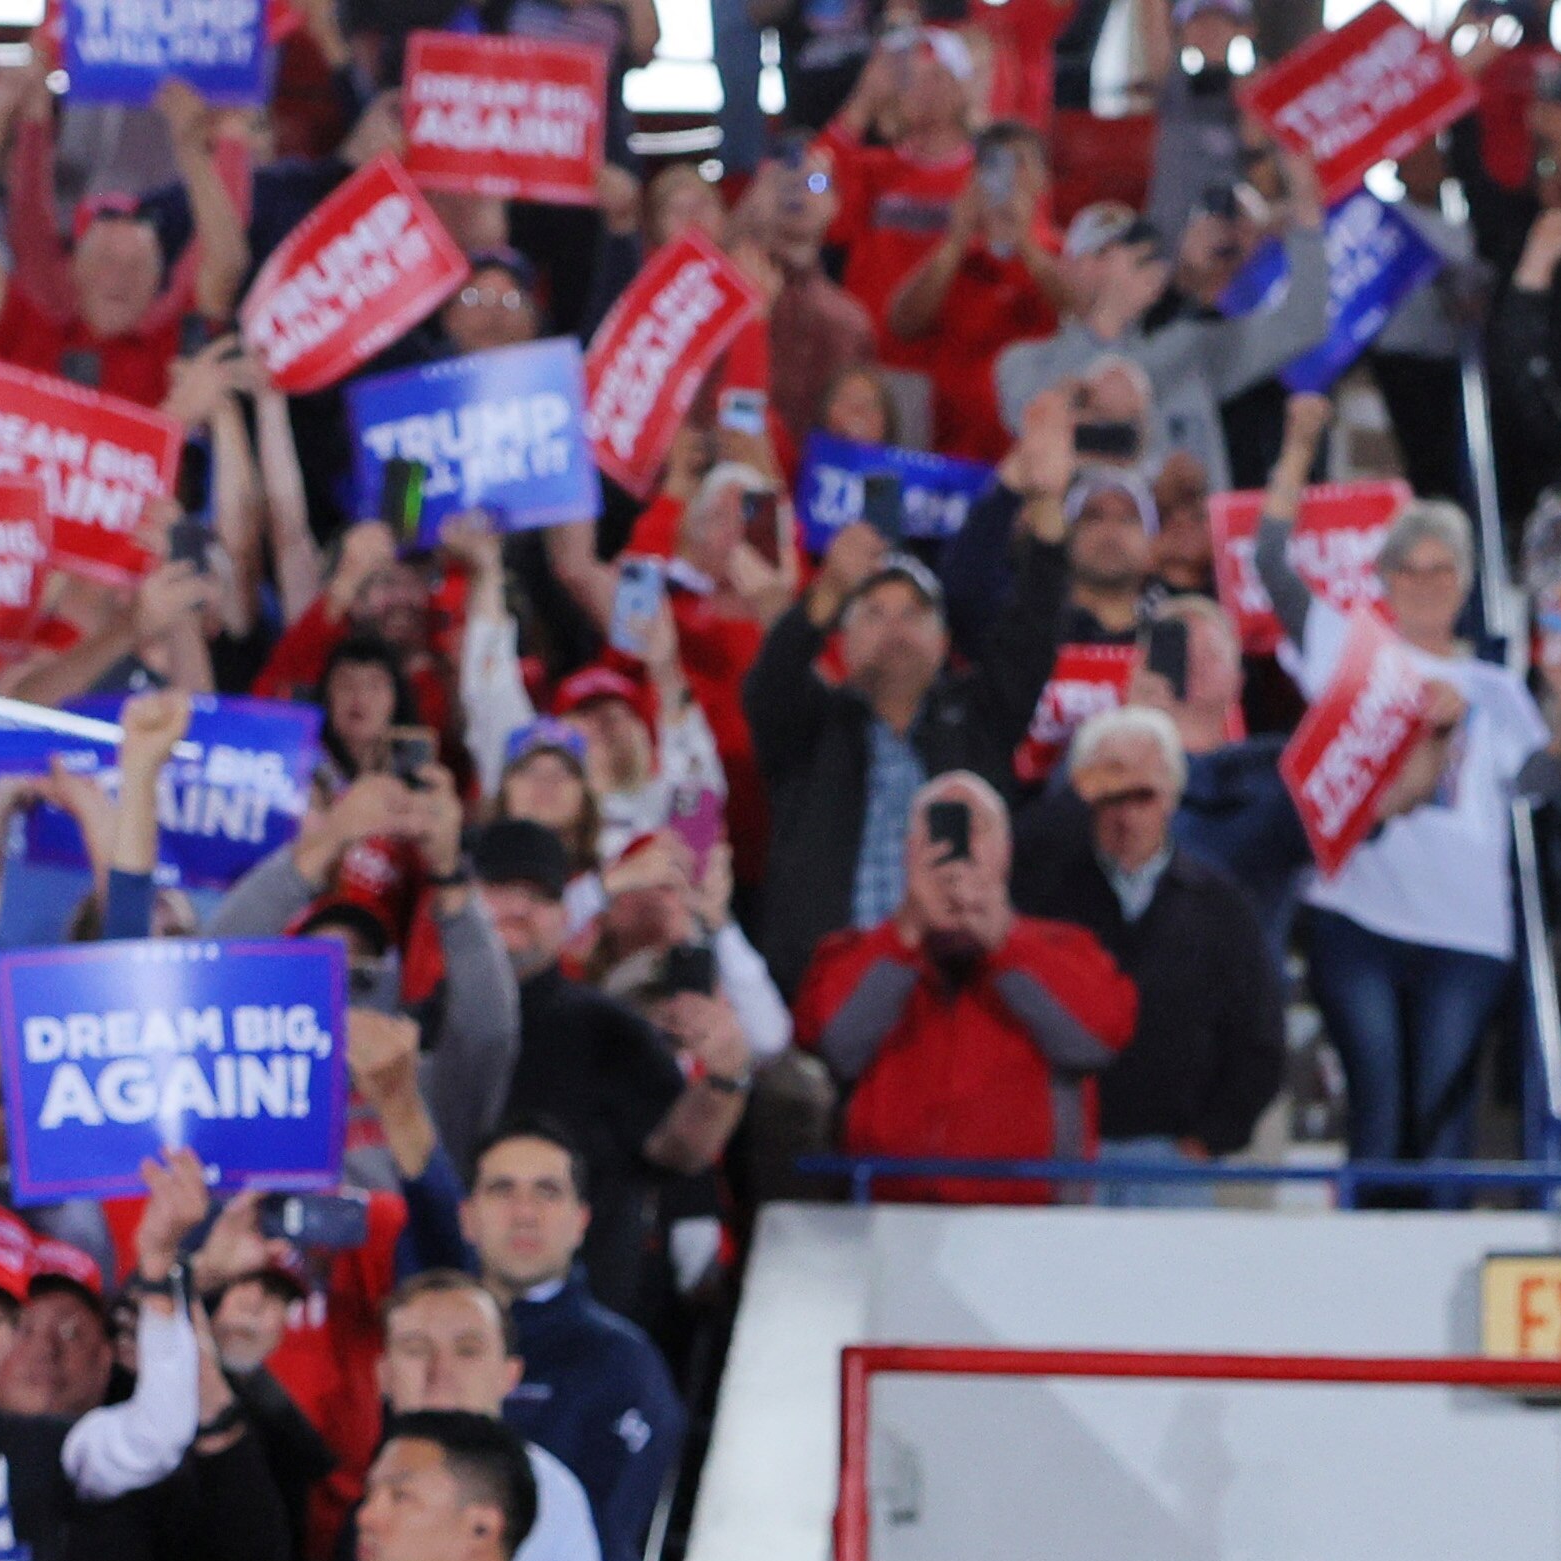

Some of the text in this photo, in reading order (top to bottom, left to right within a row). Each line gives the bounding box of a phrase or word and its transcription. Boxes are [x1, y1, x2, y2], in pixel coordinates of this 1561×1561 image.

[410, 104, 586, 157] AGAIN!
[362, 392, 571, 464] TRUMP
[22, 1004, 332, 1062] DREAM BIG,
[39, 1052, 313, 1130] AGAIN!
